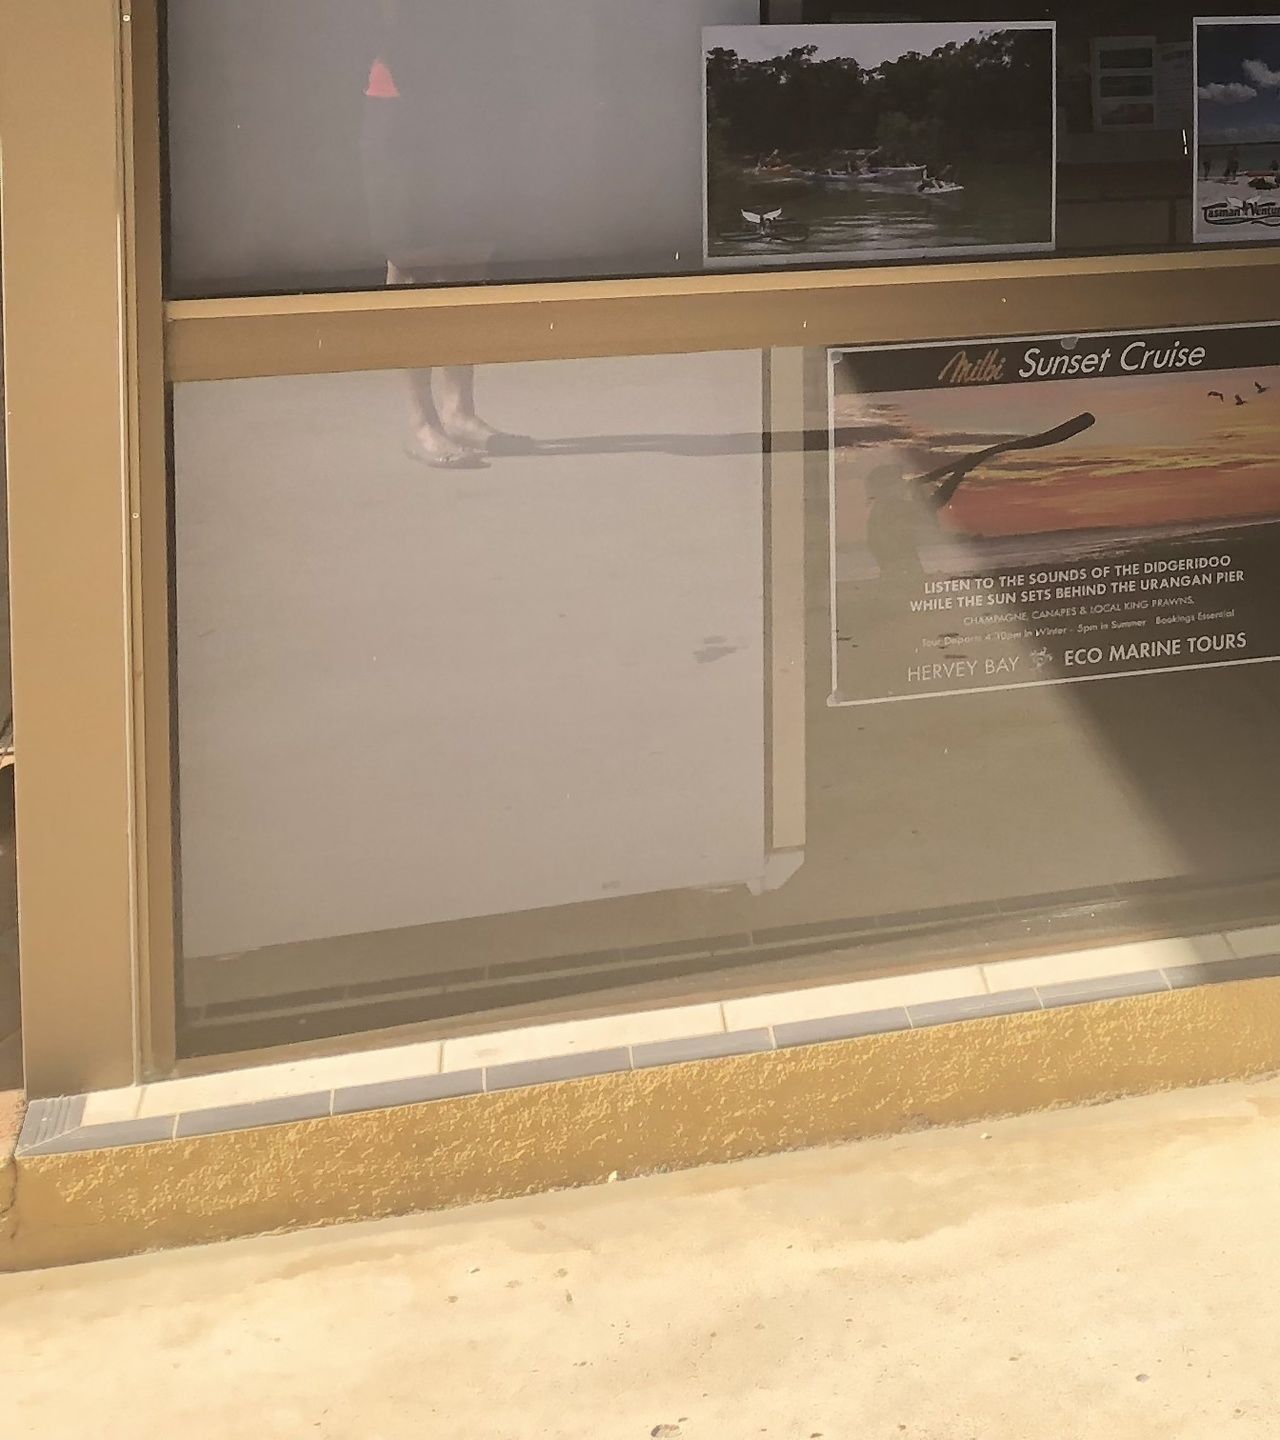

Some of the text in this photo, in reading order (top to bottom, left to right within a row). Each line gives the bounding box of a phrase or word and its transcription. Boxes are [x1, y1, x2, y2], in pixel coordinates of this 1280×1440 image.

[1018, 347, 1112, 378] Sunset
[1119, 340, 1206, 371] Cruise
[910, 570, 1245, 612] WHILE THE SUN SETS BEHIND THE URANGAN PIER
[924, 555, 1231, 594] LISTEN TO THE SOUNDS OF THE DIDGERIDOO
[1031, 607, 1077, 620] CANAPES
[1090, 603, 1121, 615] LOCAL
[1124, 600, 1149, 611] KING
[1035, 626, 1068, 637] Winter
[1111, 619, 1147, 630] Summer
[1155, 613, 1195, 626] Bookings
[908, 631, 1248, 682] HERVEY BAY ECO MARINE TOURS
